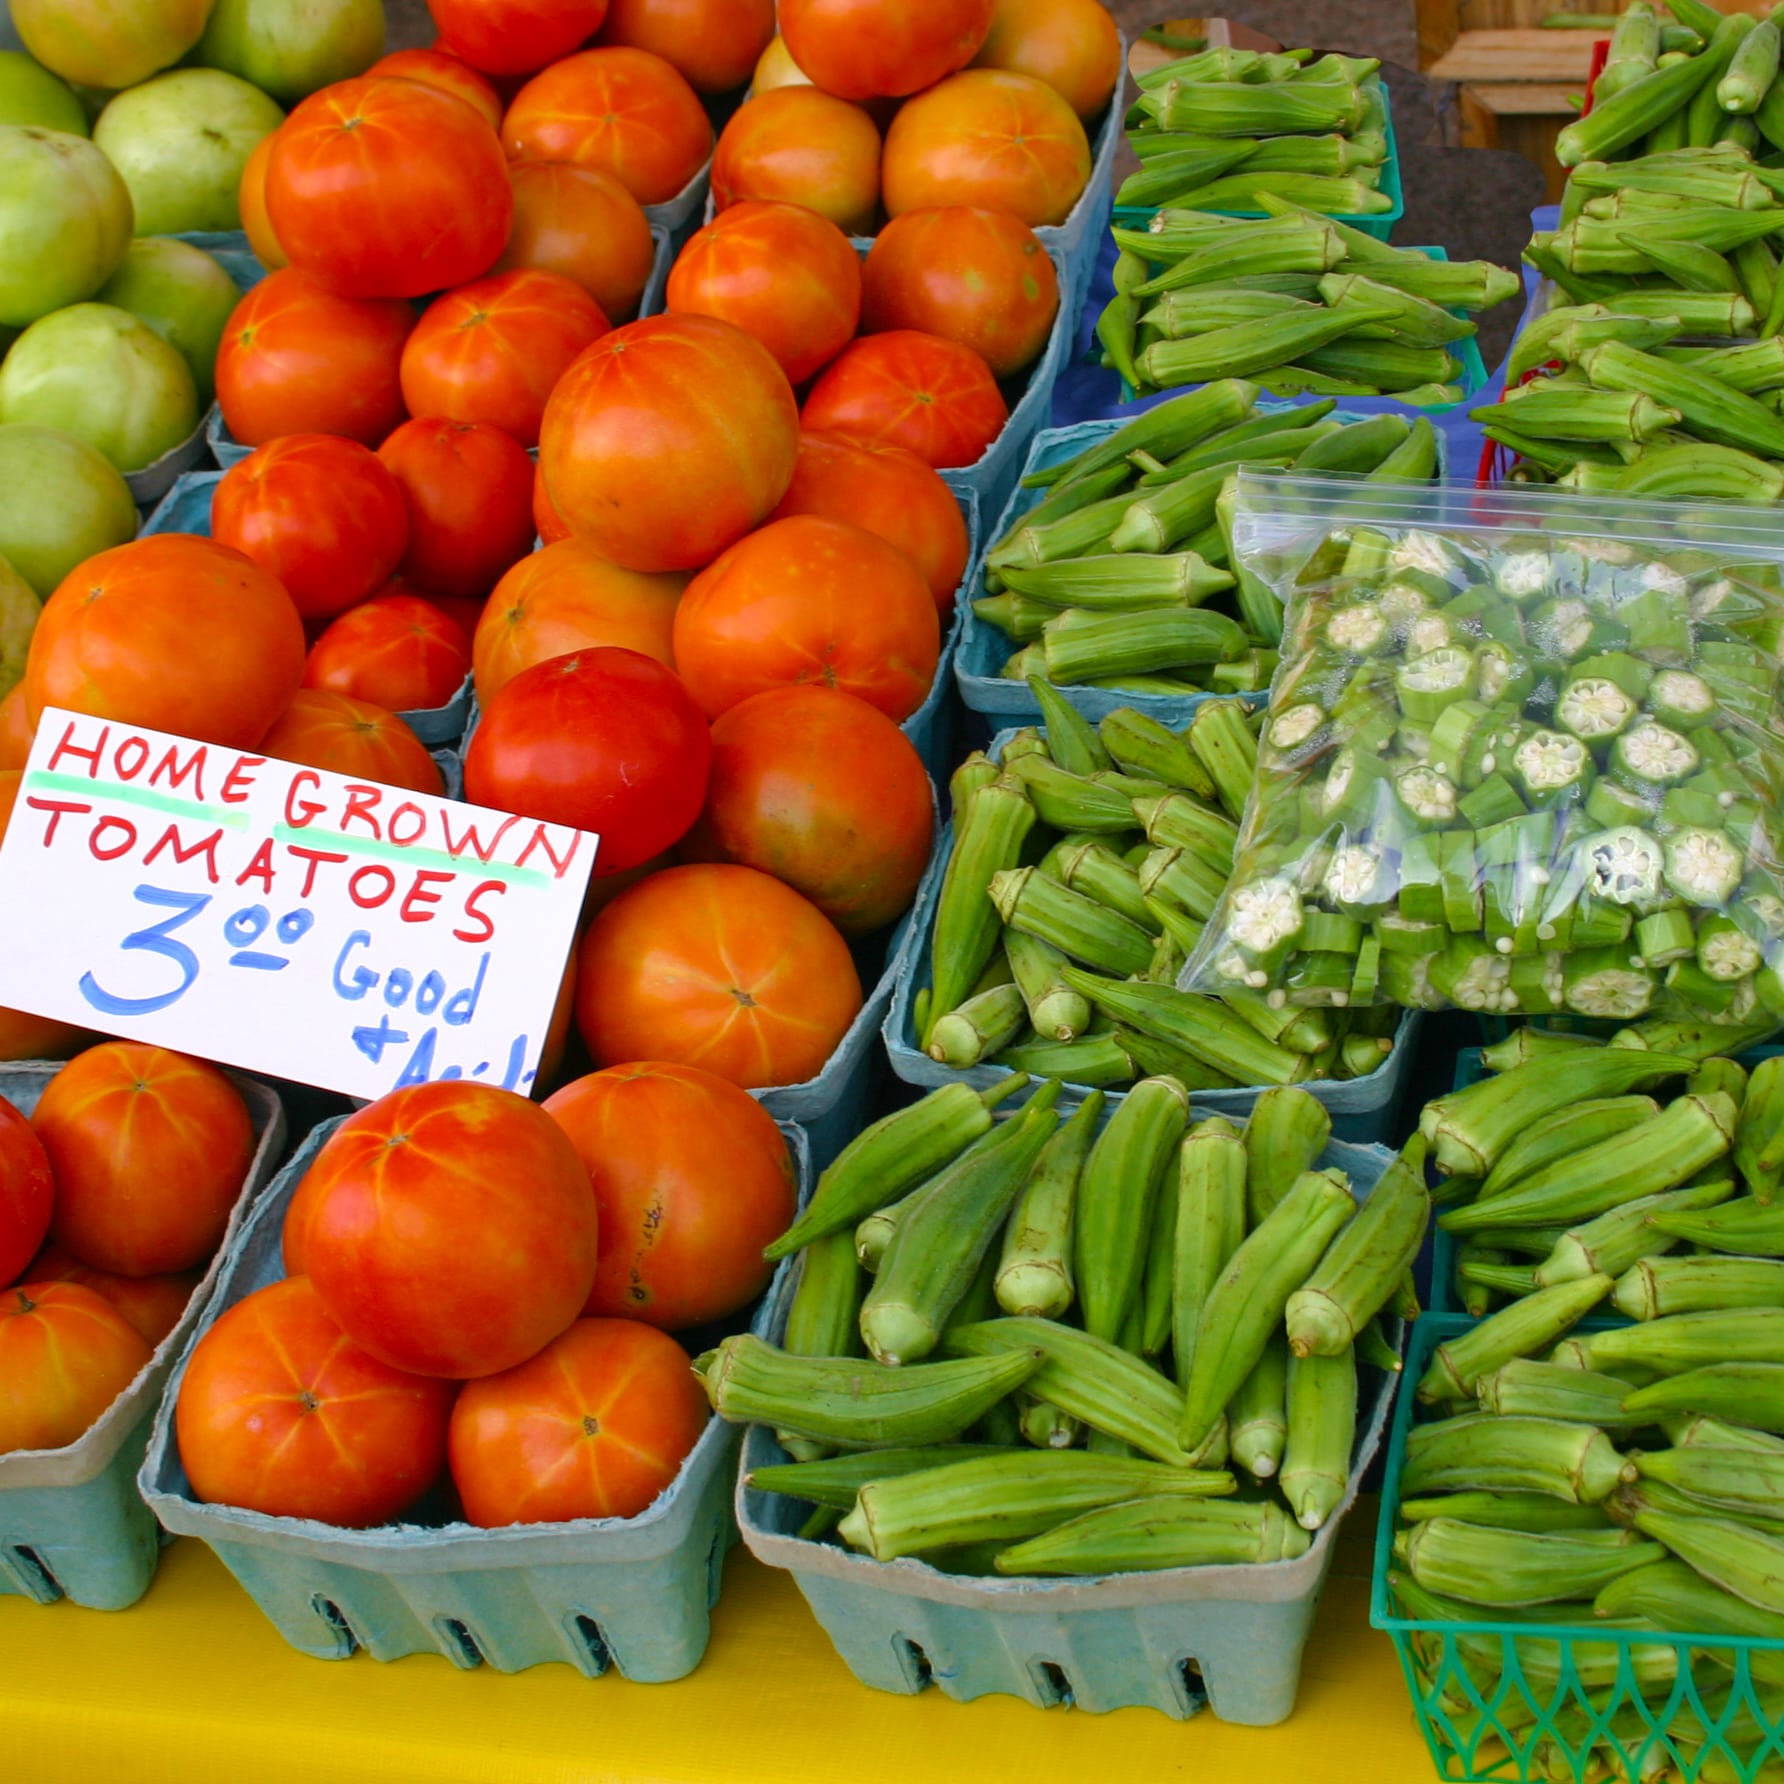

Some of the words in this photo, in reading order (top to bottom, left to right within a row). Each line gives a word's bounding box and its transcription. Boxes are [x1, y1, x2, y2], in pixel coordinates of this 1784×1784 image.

[26, 796, 507, 943] TOMATOES
[47, 722, 267, 803] HOME
[284, 770, 582, 879] GROWN
[332, 930, 491, 1027] Good
